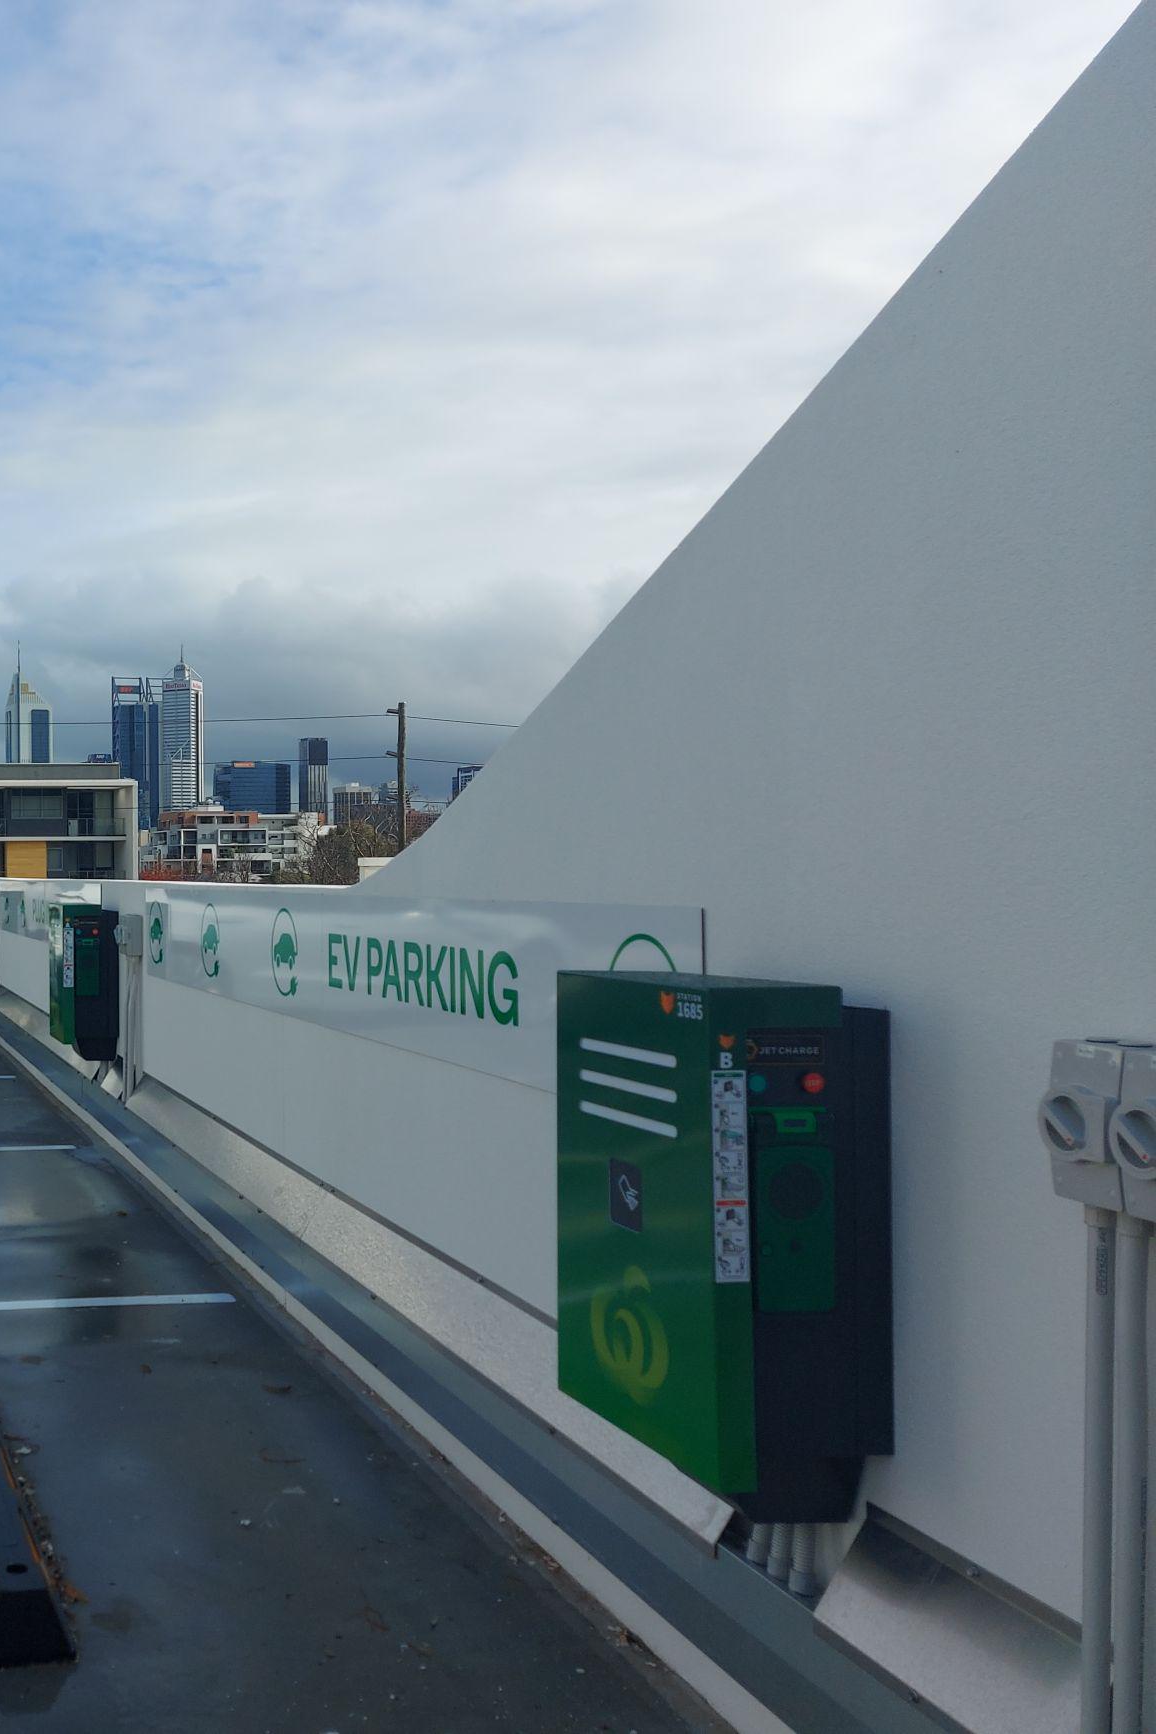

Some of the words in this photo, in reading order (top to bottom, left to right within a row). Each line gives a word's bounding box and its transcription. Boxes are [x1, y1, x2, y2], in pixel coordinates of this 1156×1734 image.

[328, 933, 360, 992] EV
[366, 937, 519, 1027] PARKING
[677, 1002, 703, 1020] 1685
[778, 1046, 820, 1055] CHARGE
[719, 1052, 733, 1068] B
